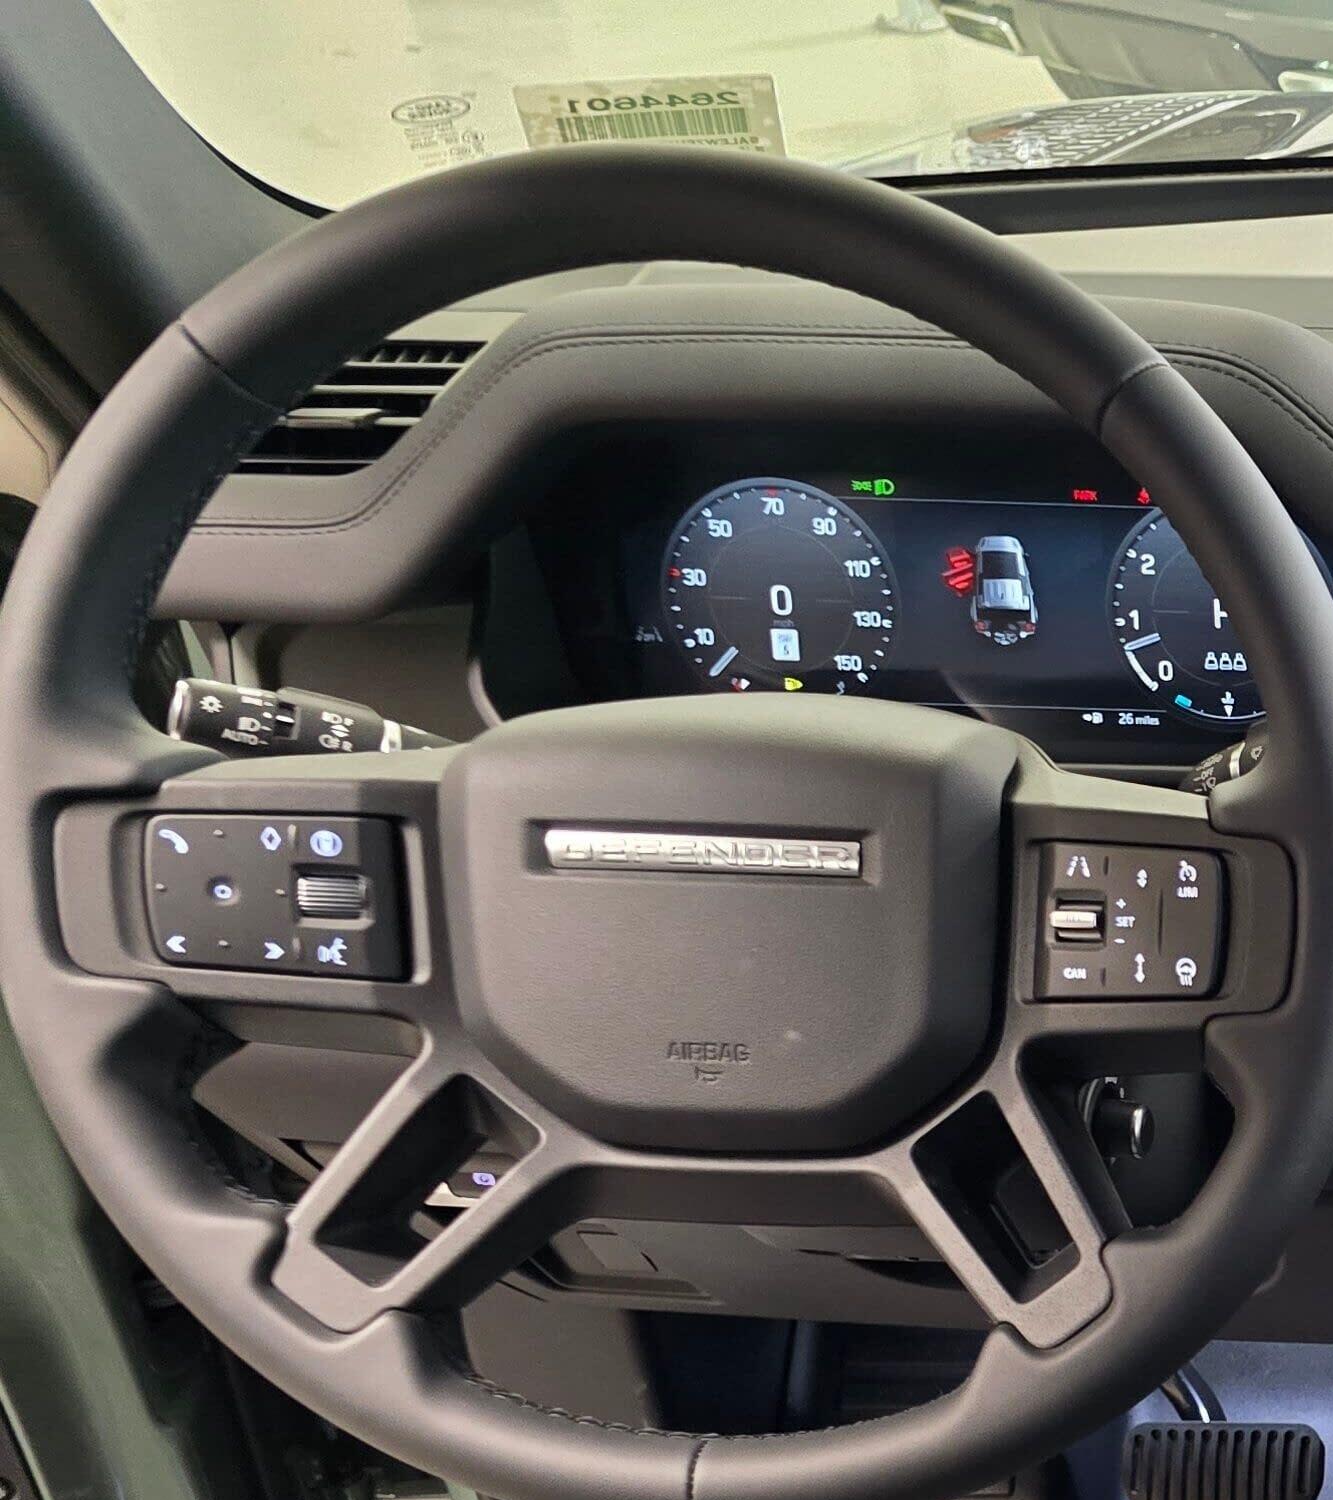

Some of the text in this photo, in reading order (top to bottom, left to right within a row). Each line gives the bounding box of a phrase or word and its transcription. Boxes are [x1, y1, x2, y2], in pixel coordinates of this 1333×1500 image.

[761, 497, 784, 515] 70
[708, 519, 732, 537] 50
[812, 518, 837, 536] 90
[844, 559, 871, 578] 110
[1140, 554, 1156, 575] 2
[682, 568, 707, 586] 30
[770, 584, 793, 616] 0
[853, 611, 881, 628] 130
[1129, 609, 1139, 630] 1
[694, 628, 714, 646] 10
[833, 655, 862, 671] 150
[1158, 660, 1173, 681] 0
[1118, 712, 1134, 725] 26
[561, 839, 850, 870] DEFENDER
[1115, 916, 1136, 928] SET
[666, 1041, 751, 1062] AIRBAG
